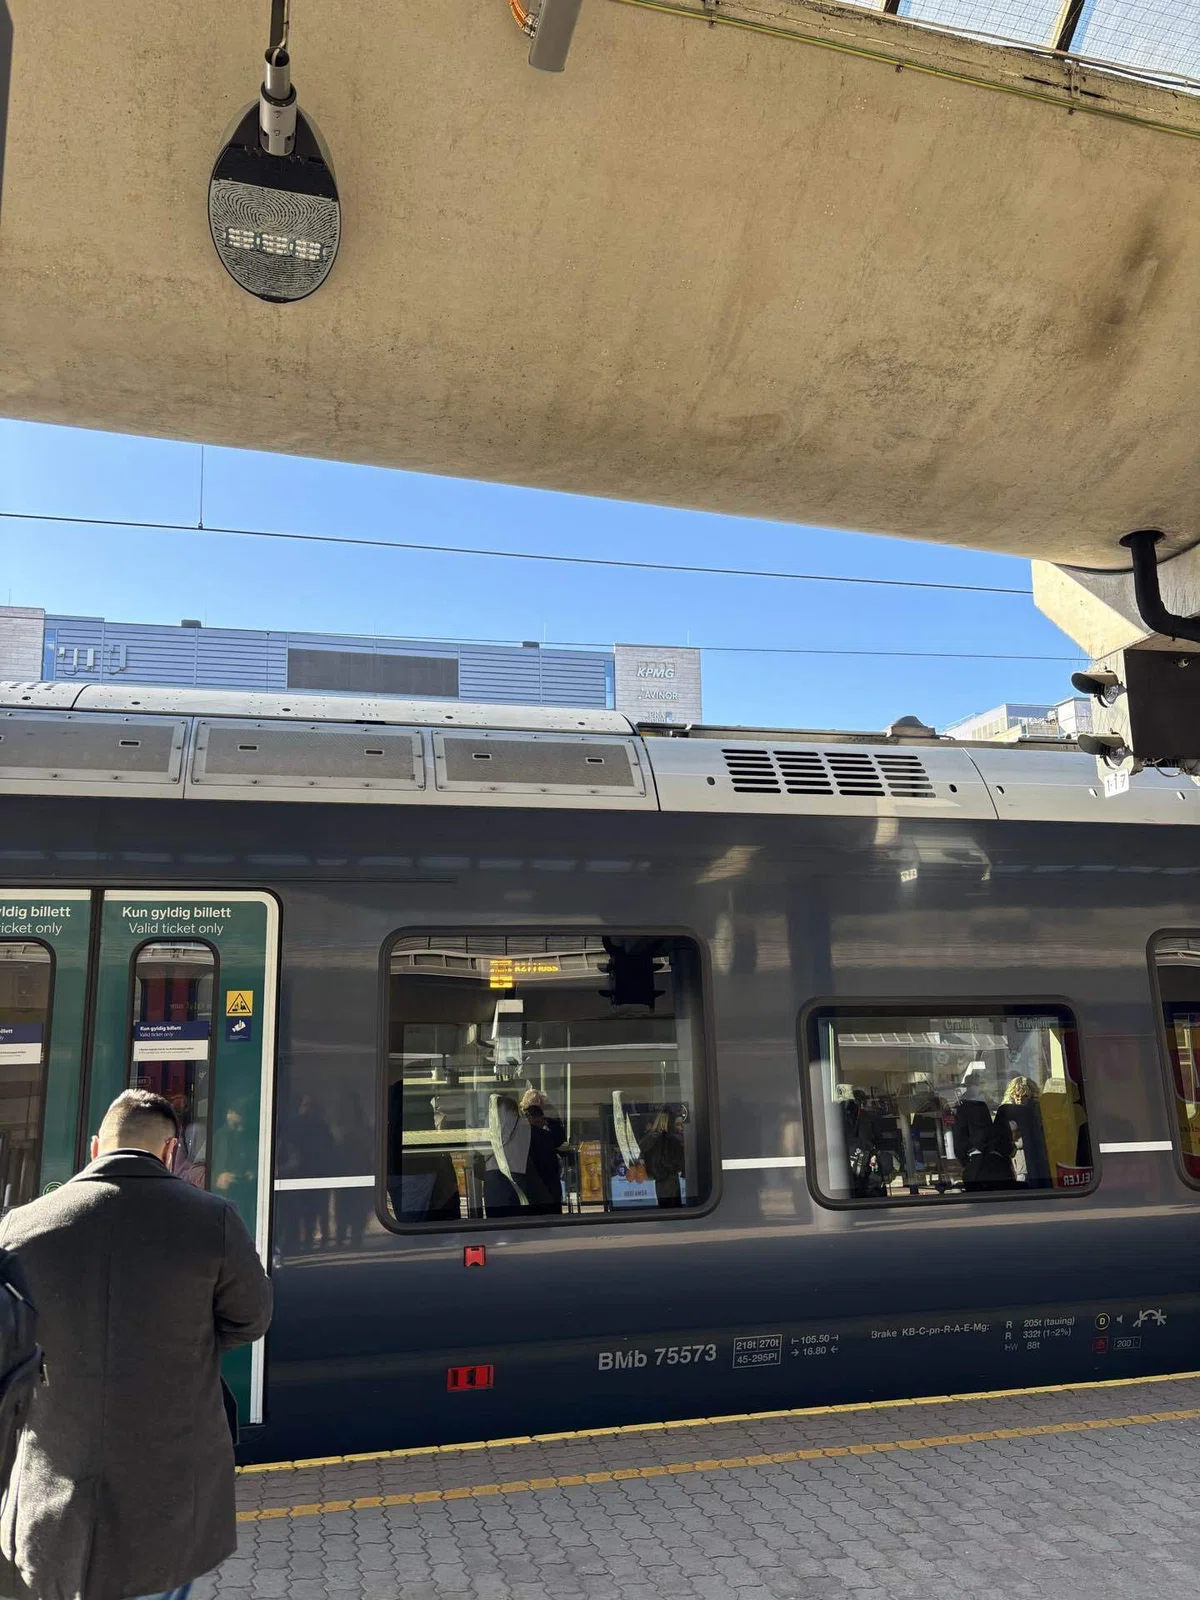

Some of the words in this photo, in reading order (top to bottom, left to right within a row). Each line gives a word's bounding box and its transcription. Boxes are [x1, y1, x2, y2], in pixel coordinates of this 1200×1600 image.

[637, 667, 675, 678] KPMG
[645, 690, 680, 700] AVINOR
[31, 906, 71, 917] billett
[122, 906, 148, 918] Kun
[151, 906, 191, 920] gyldig
[193, 907, 232, 918] billett
[0, 922, 32, 934] icket
[35, 922, 63, 936] only
[129, 922, 159, 934] Valid
[162, 923, 196, 934] ticket
[198, 922, 224, 936] only
[1006, 1320, 1013, 1329] R
[1023, 1318, 1042, 1328] 205t
[1043, 1316, 1075, 1328] (tauing)
[801, 1334, 830, 1345] 105.50
[871, 1329, 897, 1339] Brake
[1005, 1331, 1012, 1340] R
[1022, 1330, 1041, 1339] 332t
[736, 1340, 757, 1350] 218t
[759, 1338, 780, 1348] 270t
[1026, 1341, 1041, 1350] 88t
[1117, 1339, 1132, 1348] 200
[803, 1346, 827, 1356] 16.80
[598, 1350, 648, 1371] BMb
[654, 1343, 717, 1366] 75573
